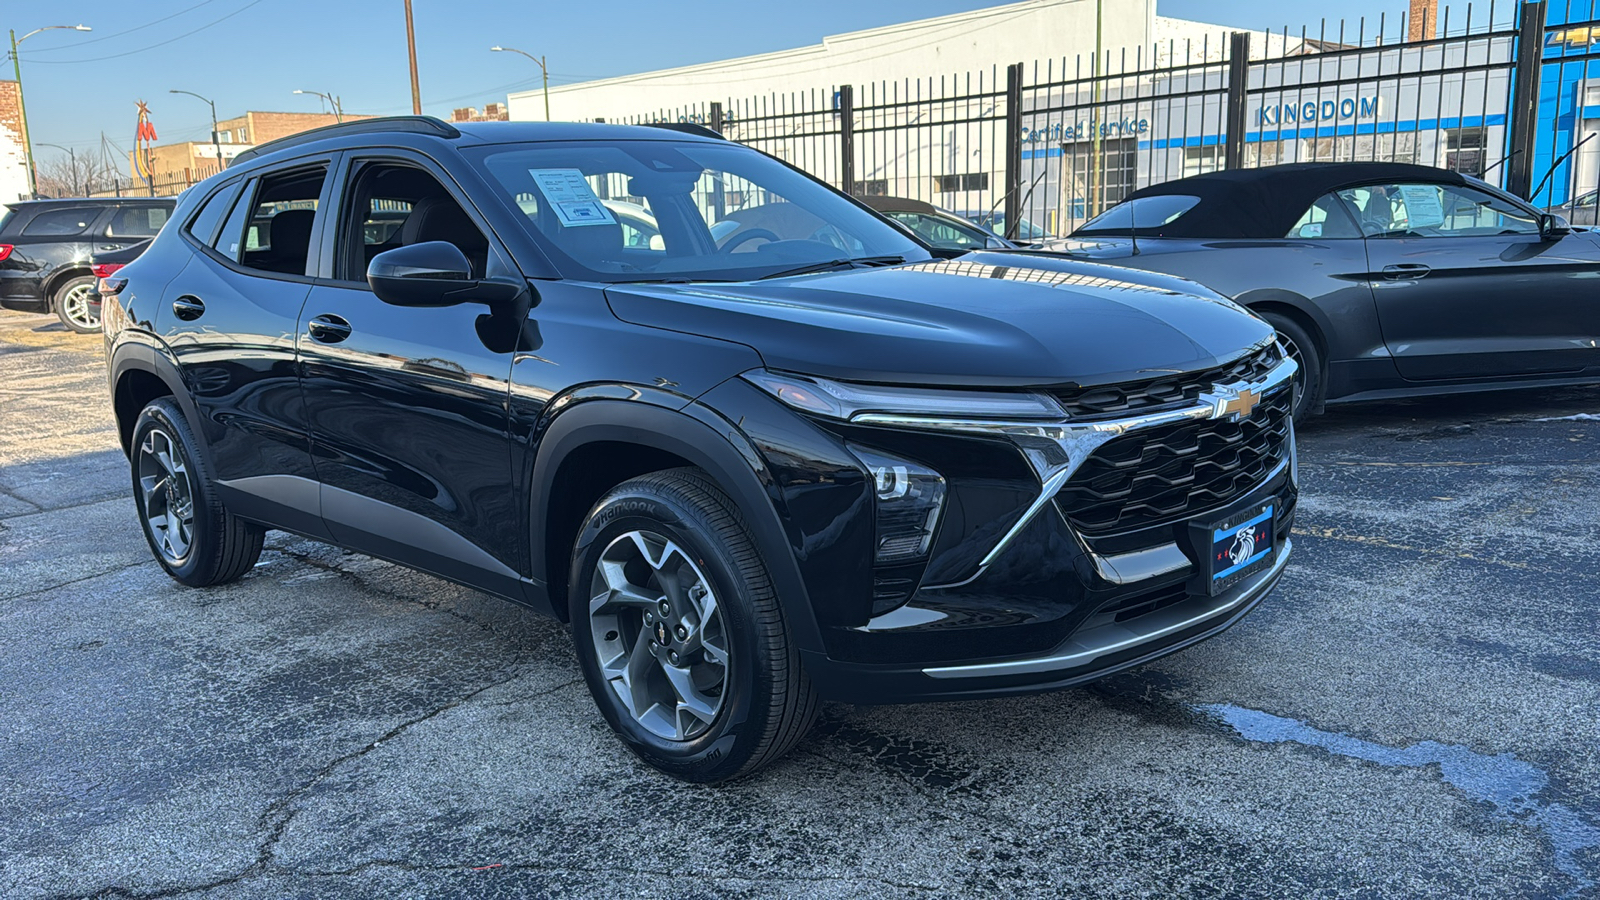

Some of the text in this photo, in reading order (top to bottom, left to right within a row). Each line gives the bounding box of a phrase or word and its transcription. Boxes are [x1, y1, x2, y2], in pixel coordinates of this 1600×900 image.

[1259, 97, 1378, 125] KINGDOM
[1020, 120, 1084, 143] Certifed
[600, 501, 656, 524] Hankook
